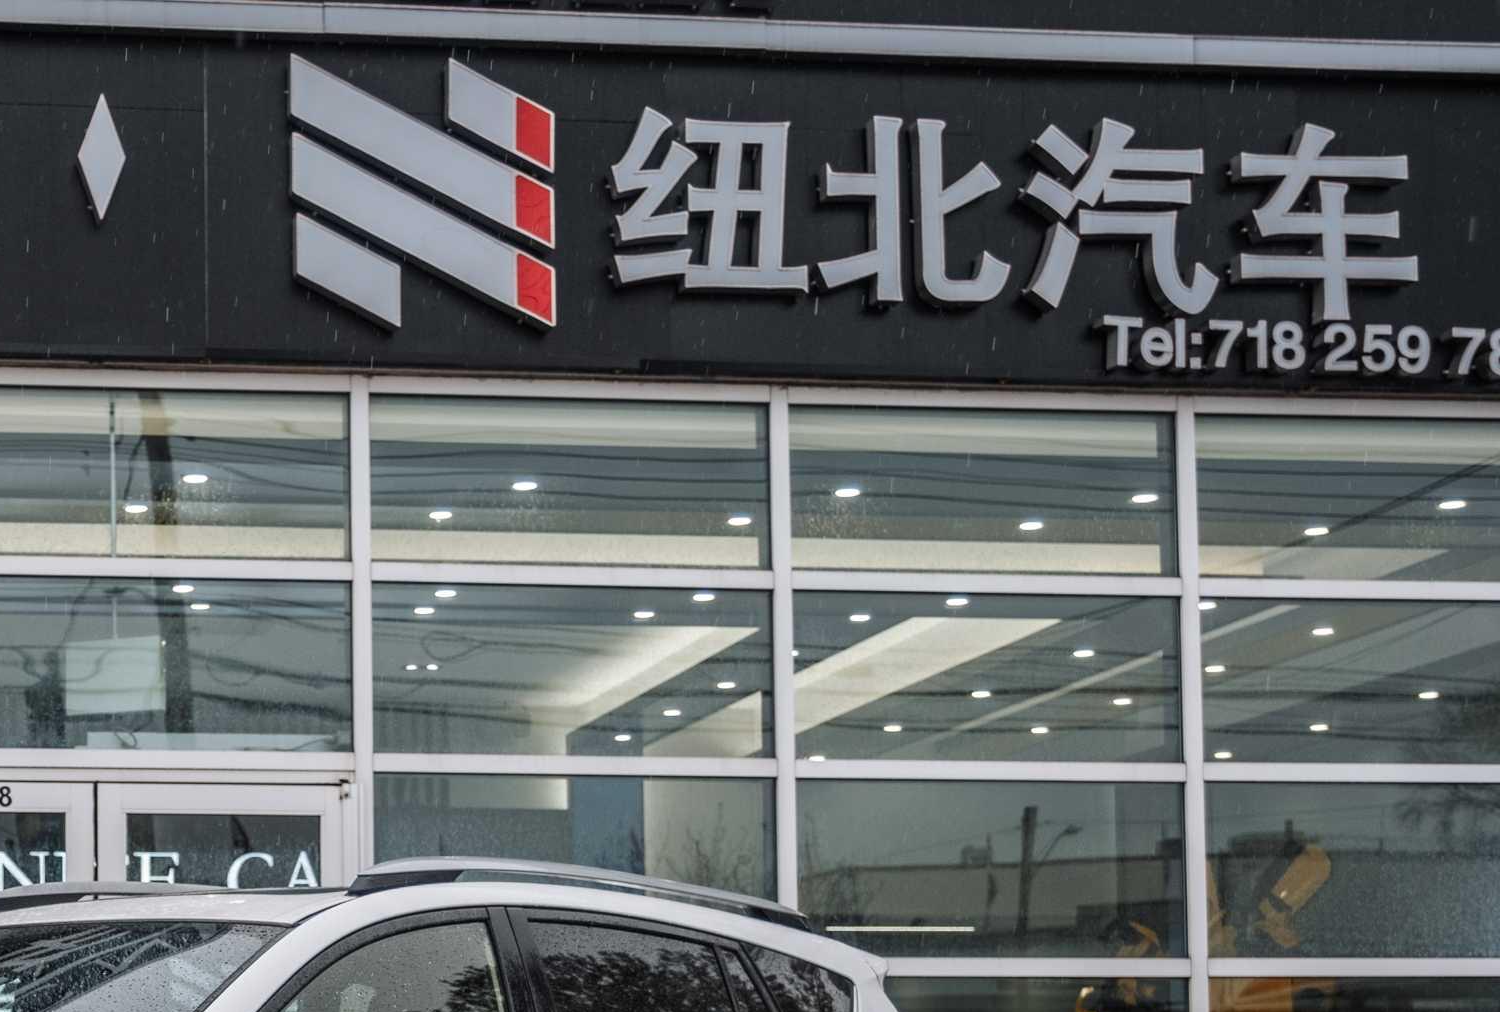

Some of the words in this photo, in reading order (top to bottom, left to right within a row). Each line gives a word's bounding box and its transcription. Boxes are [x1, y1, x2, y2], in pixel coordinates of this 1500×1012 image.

[610, 106, 1420, 322] 纽北汽车
[1322, 324, 1431, 374] 259
